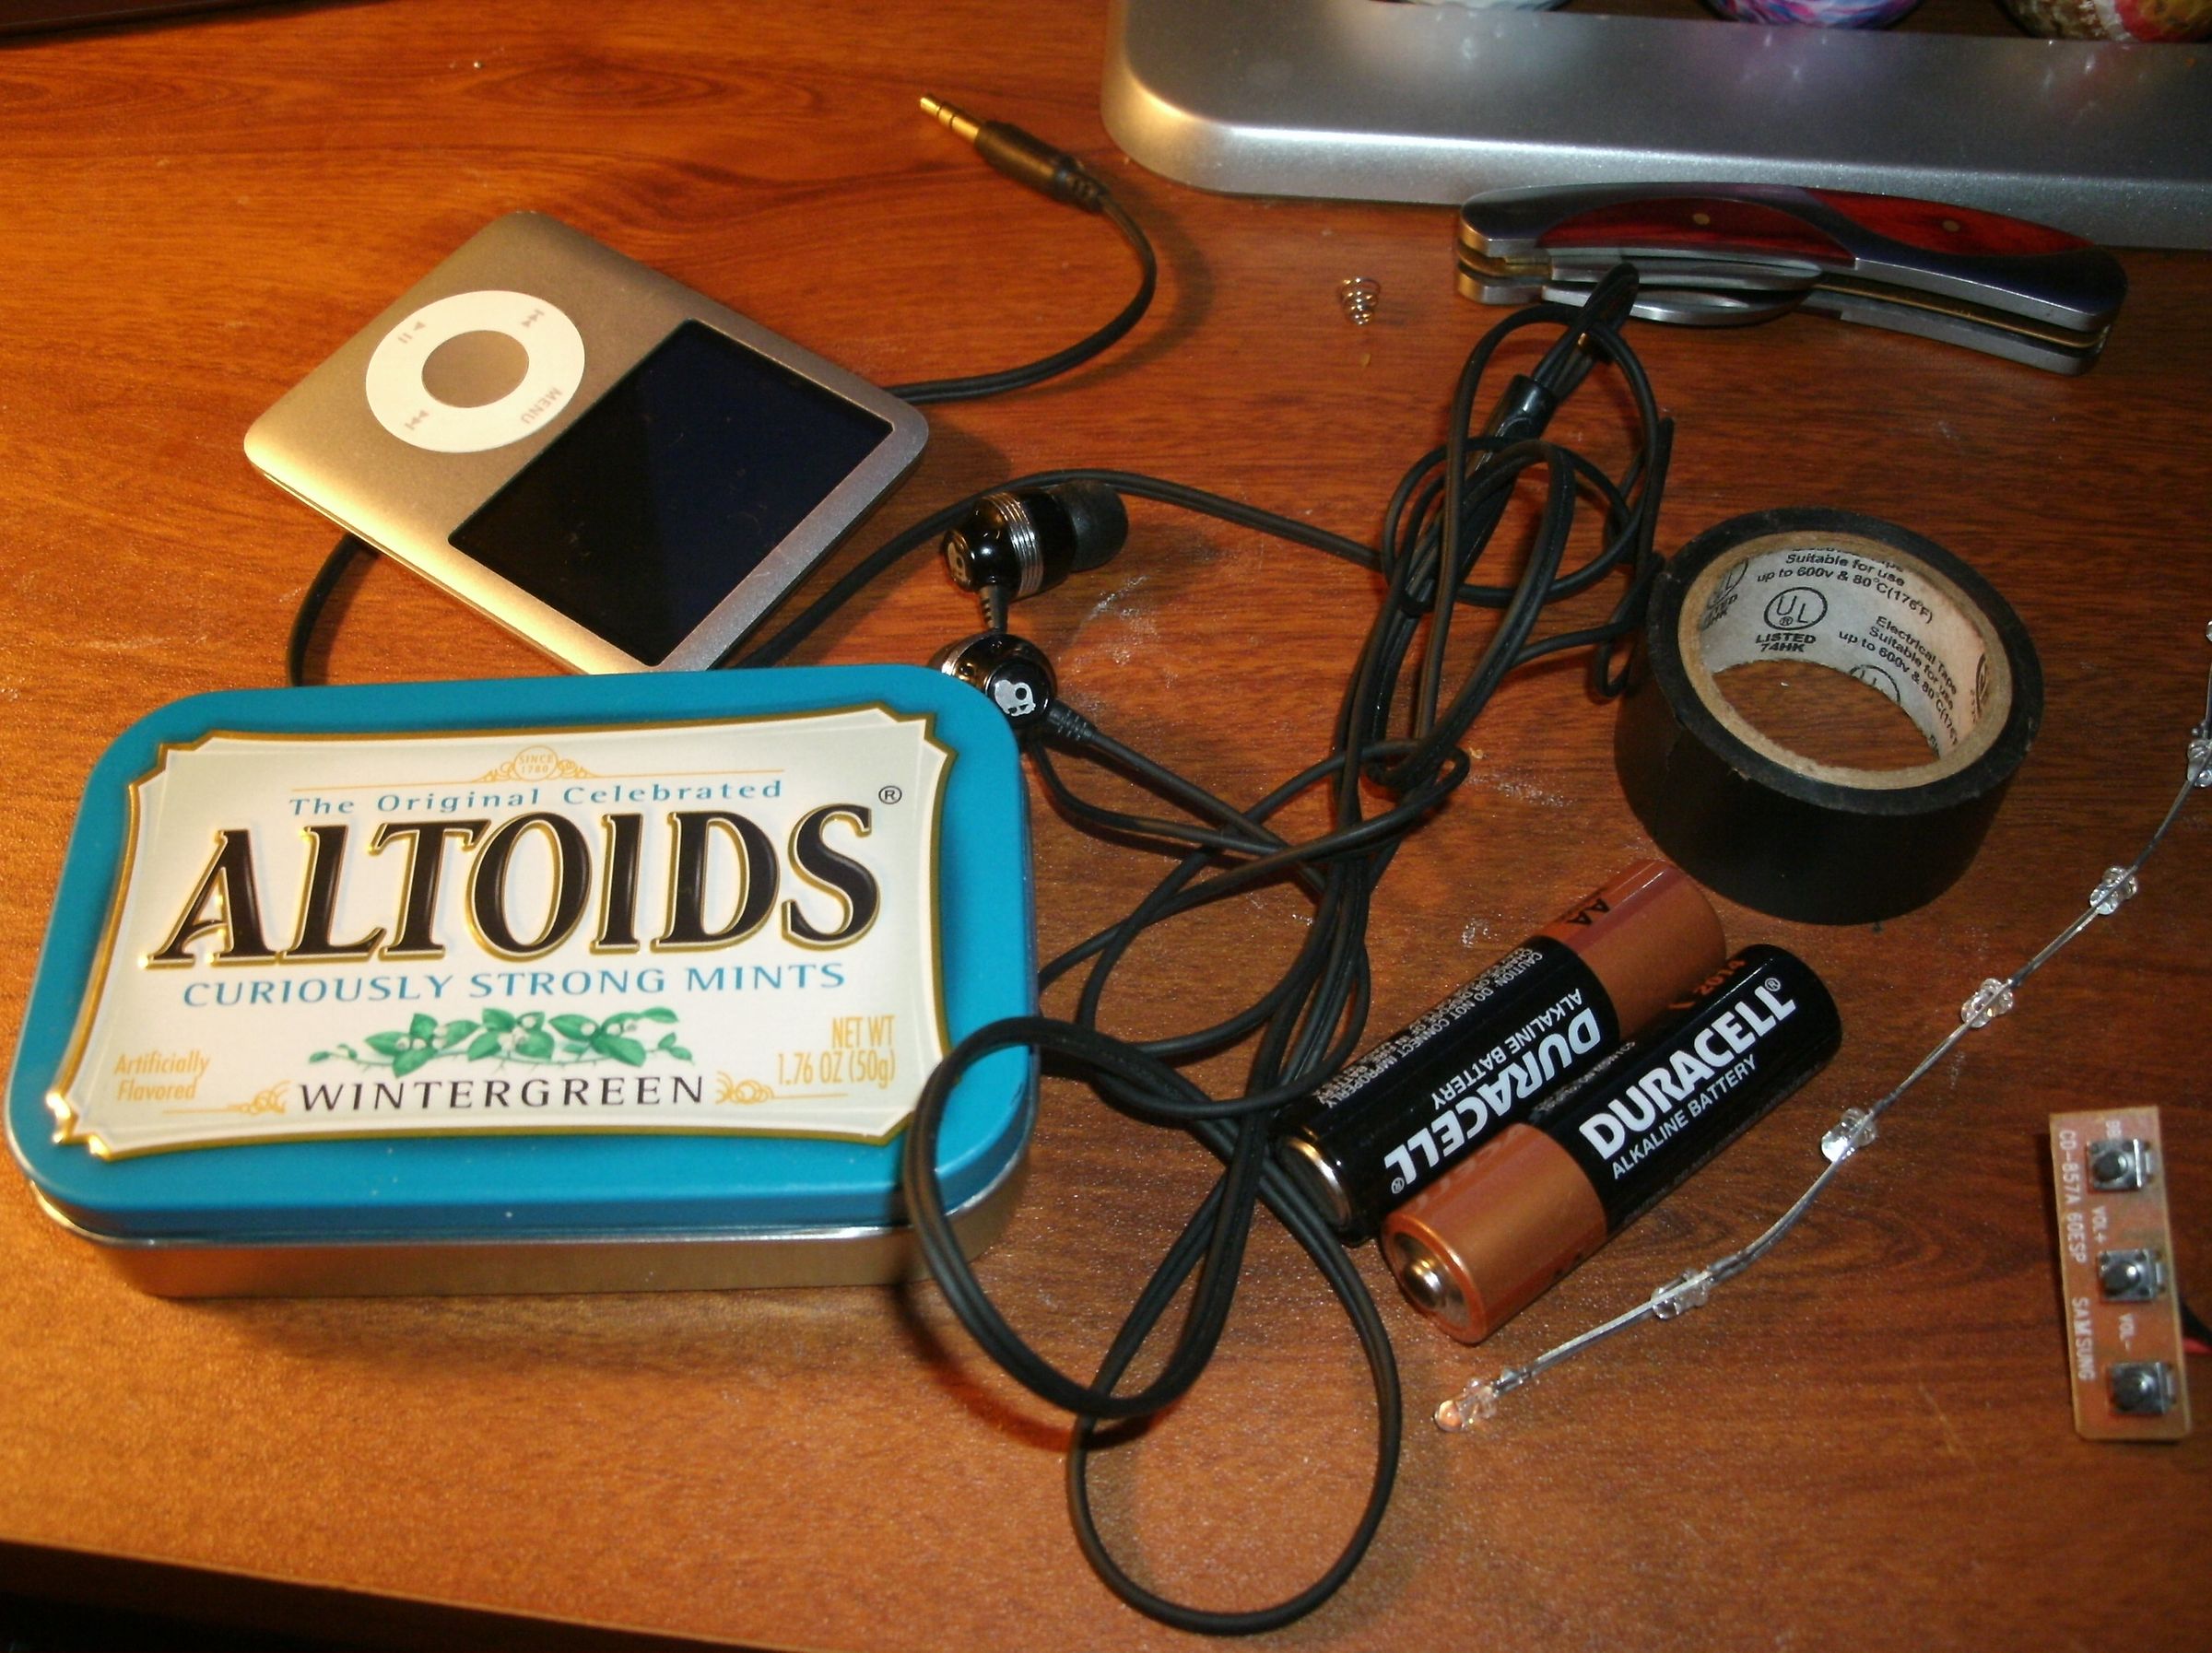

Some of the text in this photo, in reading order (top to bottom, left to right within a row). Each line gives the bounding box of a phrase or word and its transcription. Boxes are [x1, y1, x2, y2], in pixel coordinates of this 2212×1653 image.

[521, 386, 563, 425] MENU
[1758, 571, 1775, 582] up
[1779, 569, 1793, 579] to
[1798, 567, 1834, 579] 600v
[1837, 570, 1849, 581] &
[1785, 554, 1848, 567] Suitable
[1853, 559, 1875, 573] for
[1877, 569, 1905, 587] use
[1756, 632, 1817, 644] LISTED
[1839, 630, 1858, 644] up
[1862, 639, 1876, 651] to
[1869, 627, 1922, 666] Suitable
[1924, 664, 1938, 684] for
[1876, 615, 1936, 665] Electrical
[1938, 661, 1957, 695] Tape
[289, 780, 782, 815] The Original Celebrated
[145, 804, 881, 969] ALTOIDS
[1570, 897, 1610, 927] AA
[182, 962, 846, 1008] CURIOUSLY STRONG MINTS
[1473, 986, 1494, 1000] DO
[1449, 1000, 1476, 1019] NOT
[1504, 988, 1583, 1055] ALKALINE
[831, 1014, 895, 1049] NET WT
[1396, 1017, 1451, 1058] CONNECT
[113, 1049, 211, 1079] Artificially
[778, 1049, 896, 1089] 1.76 OZ (50g)
[1430, 1047, 1507, 1110] BATTERY
[1579, 985, 1796, 1161] DURACELL
[117, 1075, 198, 1101] Flavored
[300, 1074, 704, 1113] WINTERGREEN
[1383, 1008, 1601, 1185] DURACELL
[1612, 1109, 1689, 1180] ALKALINE
[1687, 1053, 1757, 1118] BATTERY
[2072, 1296, 2097, 1381] SAMSUNG
